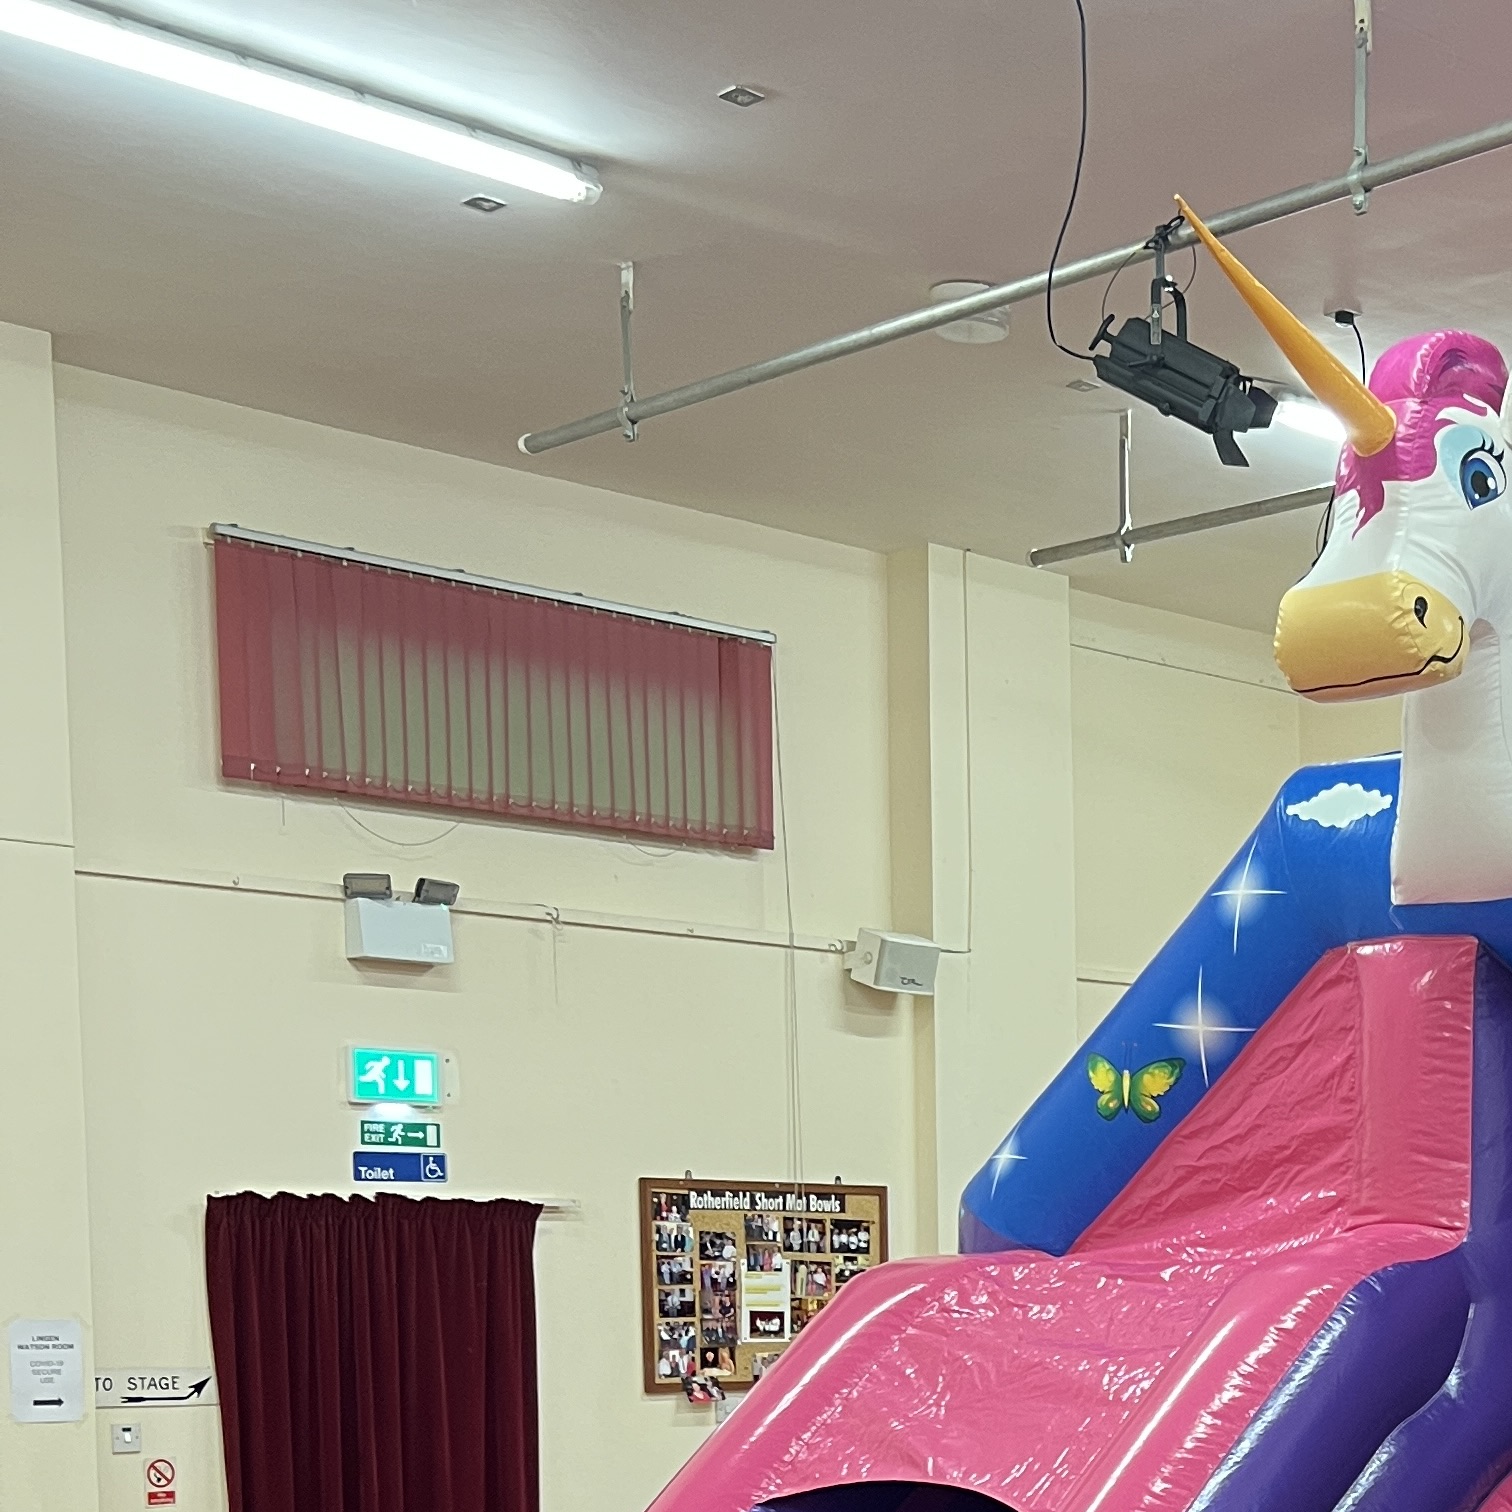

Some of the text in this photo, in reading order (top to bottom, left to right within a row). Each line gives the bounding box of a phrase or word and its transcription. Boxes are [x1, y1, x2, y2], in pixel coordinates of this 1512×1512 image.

[364, 1124, 385, 1133] FIRE
[364, 1133, 385, 1142] EXIT
[358, 1167, 394, 1179] Toilet
[689, 1190, 841, 1213] Rotherfield Short Mat Bowls
[94, 1375, 181, 1392] TO STAGE
